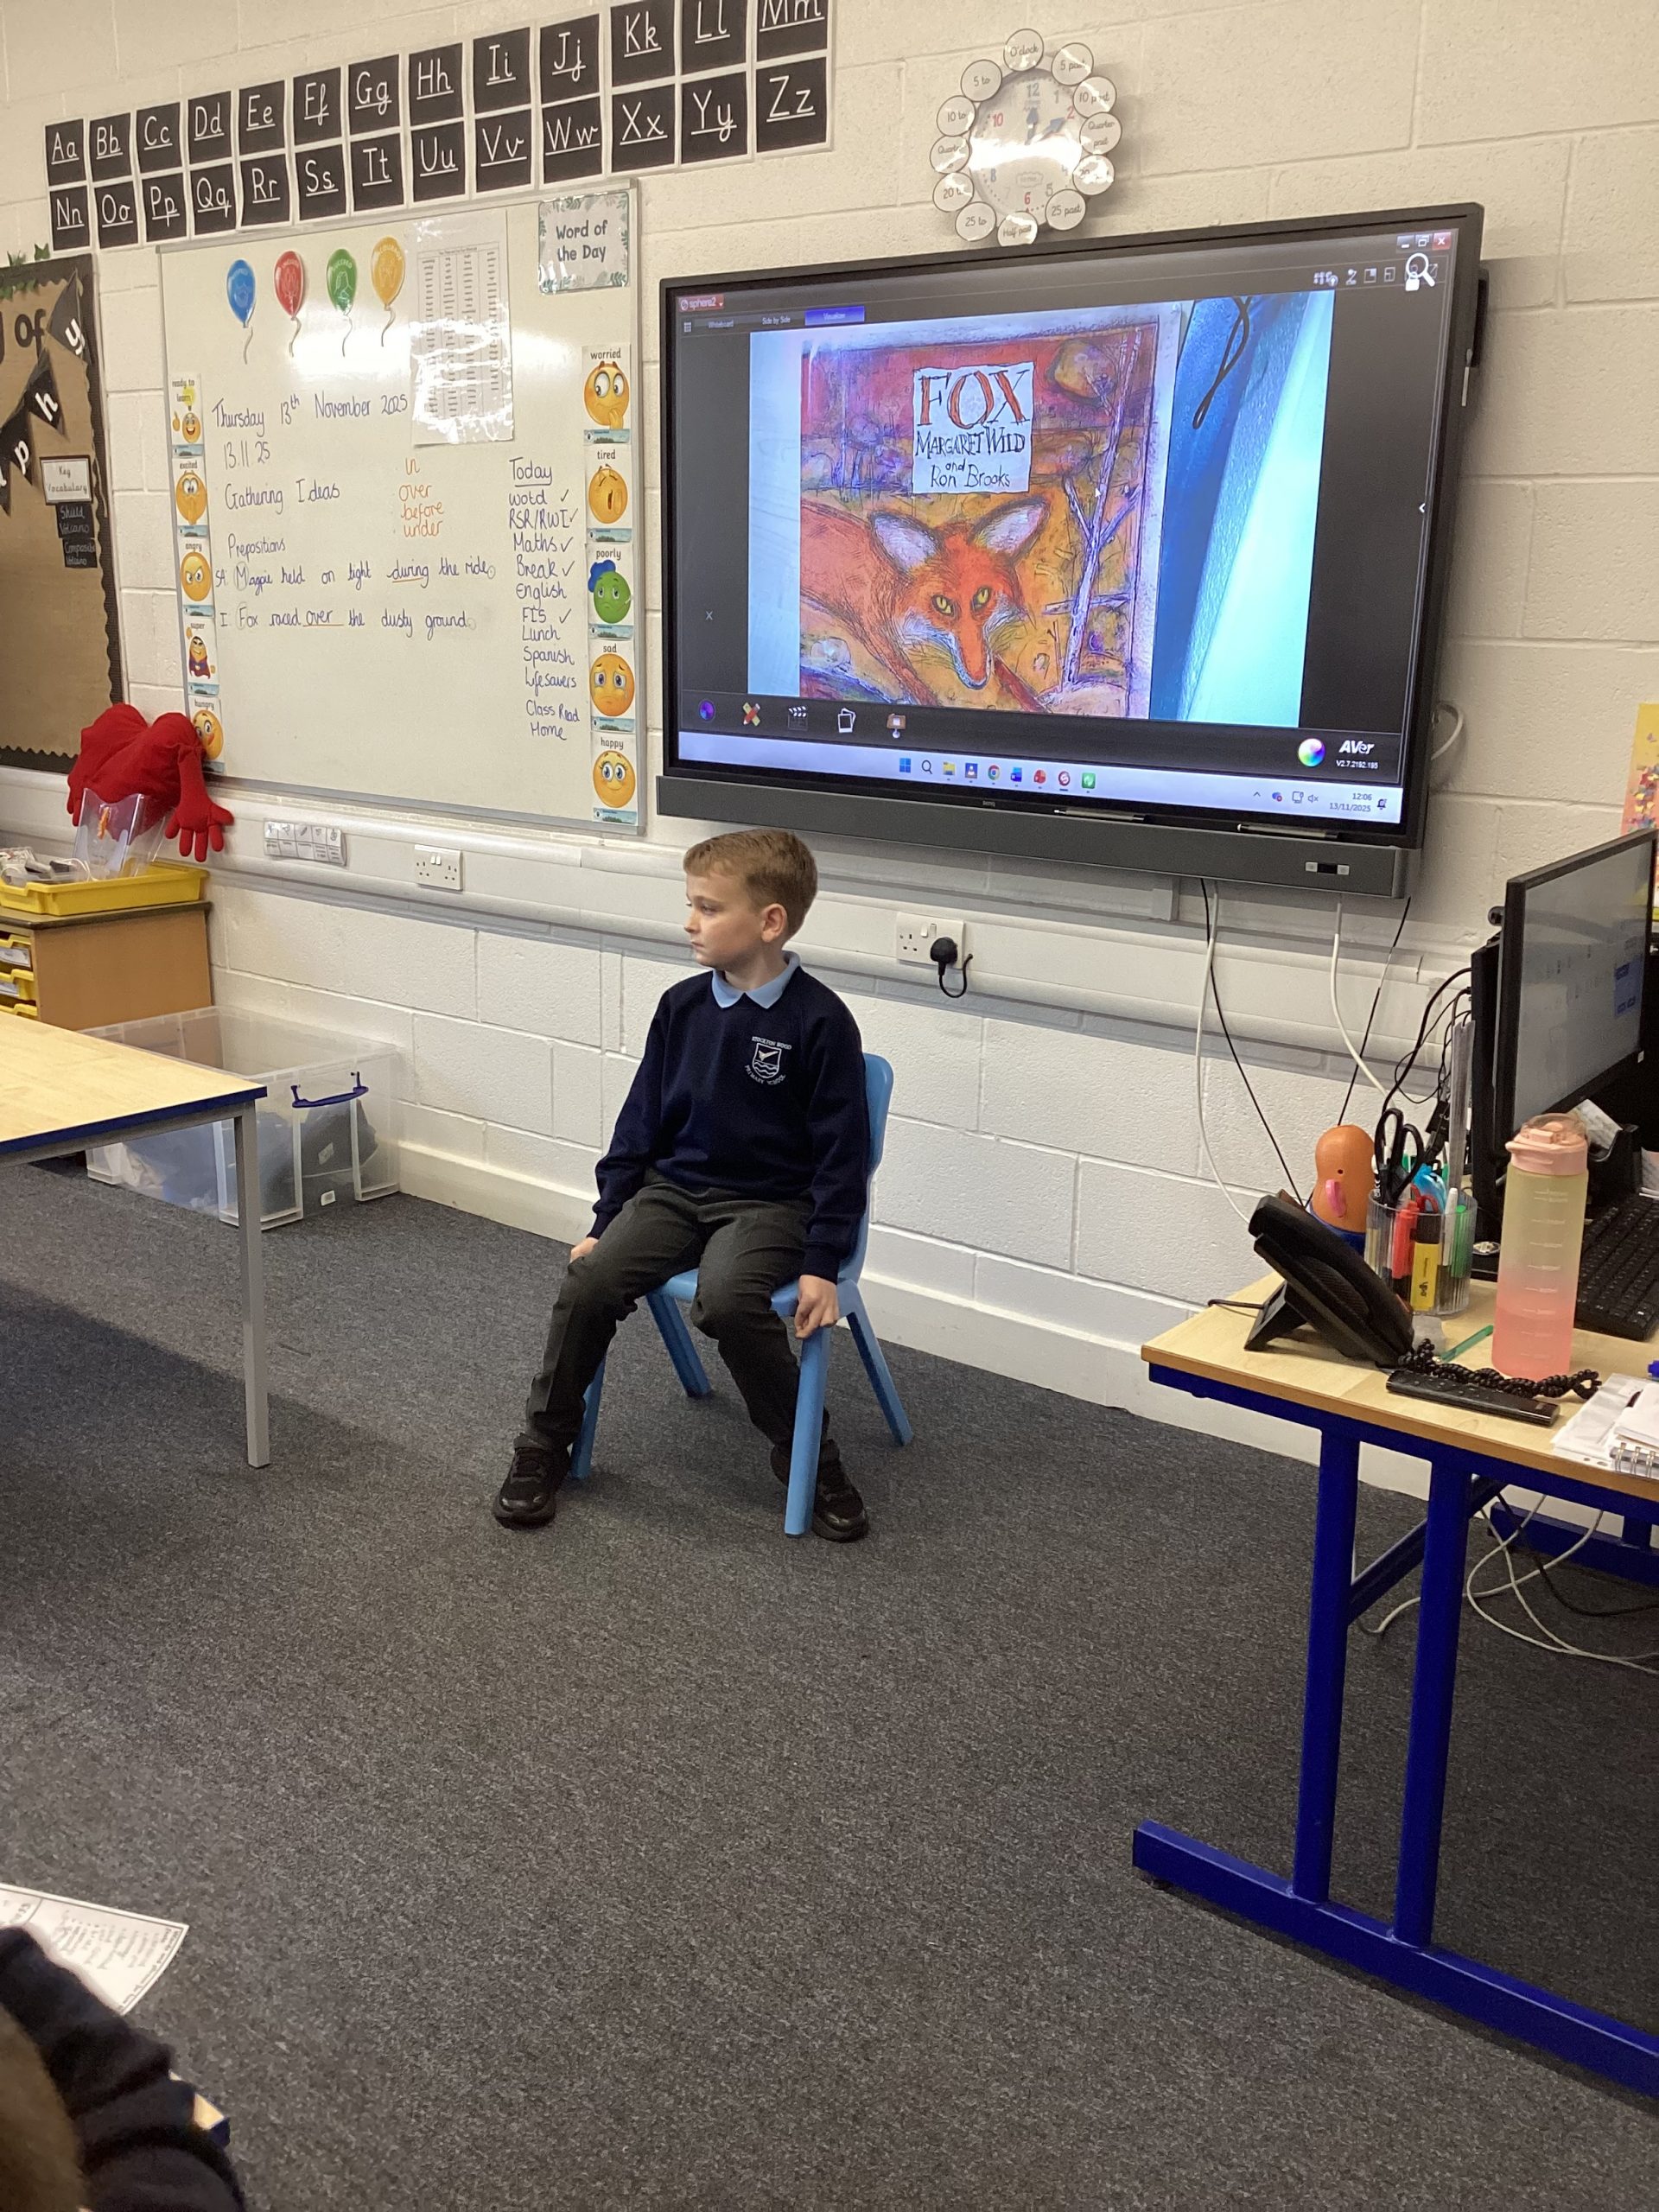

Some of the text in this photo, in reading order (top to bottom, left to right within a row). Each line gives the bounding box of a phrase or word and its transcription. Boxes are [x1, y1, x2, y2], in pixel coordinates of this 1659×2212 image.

[1010, 44, 1038, 57] O'clock
[1060, 60, 1066, 71] 5
[52, 0, 823, 162] Aa Bb Cc Dd Ee Ff Gg Hh Ii Jj Kk Ll Mm
[974, 76, 991, 87] 5 to
[1026, 82, 1040, 98] 12
[1079, 92, 1089, 103] 10
[947, 111, 967, 123] 10 to
[993, 113, 1003, 127] 10
[1066, 106, 1075, 119] 2
[56, 75, 814, 227] Nn Oo Pp Qq Rr Ss Tt Uu Vv Ww Xx Yy Zz
[944, 188, 954, 200] 20
[1046, 182, 1053, 197] 5
[1024, 192, 1031, 205] 6
[1052, 204, 1081, 218] 25 past
[965, 216, 988, 227] 25 to
[556, 219, 608, 240] Word of
[557, 245, 607, 263] the Day
[762, 316, 772, 325] Side
[780, 315, 791, 324] Side
[14, 308, 47, 365] of
[590, 348, 621, 360] worried
[917, 369, 1031, 430] FOX
[212, 391, 409, 437] Thursday 13th November 2025
[915, 426, 1027, 459] MARGARET WILD
[597, 449, 616, 460] tired
[179, 461, 198, 470] excited
[509, 456, 553, 486] Today
[945, 458, 966, 472] and
[931, 464, 1011, 488] Ron Brooks
[47, 481, 88, 495] Vocabulary
[398, 484, 432, 502] over
[225, 478, 340, 516] Gathering Ideas
[401, 501, 444, 523] before
[404, 520, 443, 537] under
[185, 542, 202, 553] angry
[227, 532, 286, 563] Prepositions
[513, 532, 558, 553] Maths
[596, 549, 621, 561] poorly
[516, 554, 558, 580] Break
[236, 565, 273, 596] Magpie
[281, 567, 306, 586] held
[321, 569, 336, 585] on
[347, 560, 372, 590] tight
[386, 556, 429, 589] during
[438, 556, 460, 577] the
[516, 582, 567, 610] English
[238, 607, 258, 628] Fox
[269, 608, 301, 627] raced
[305, 609, 334, 625] over
[348, 608, 365, 627] the
[381, 608, 414, 638] dusty
[522, 624, 561, 642] Lunch
[603, 643, 617, 653] sad
[524, 645, 575, 669] Spanish
[525, 699, 581, 722] Class Read
[530, 721, 568, 741] Home
[600, 737, 624, 750] happy
[1338, 740, 1376, 755] AVer
[1352, 792, 1372, 802] 12:06
[1329, 802, 1372, 813] 13/11/2025
